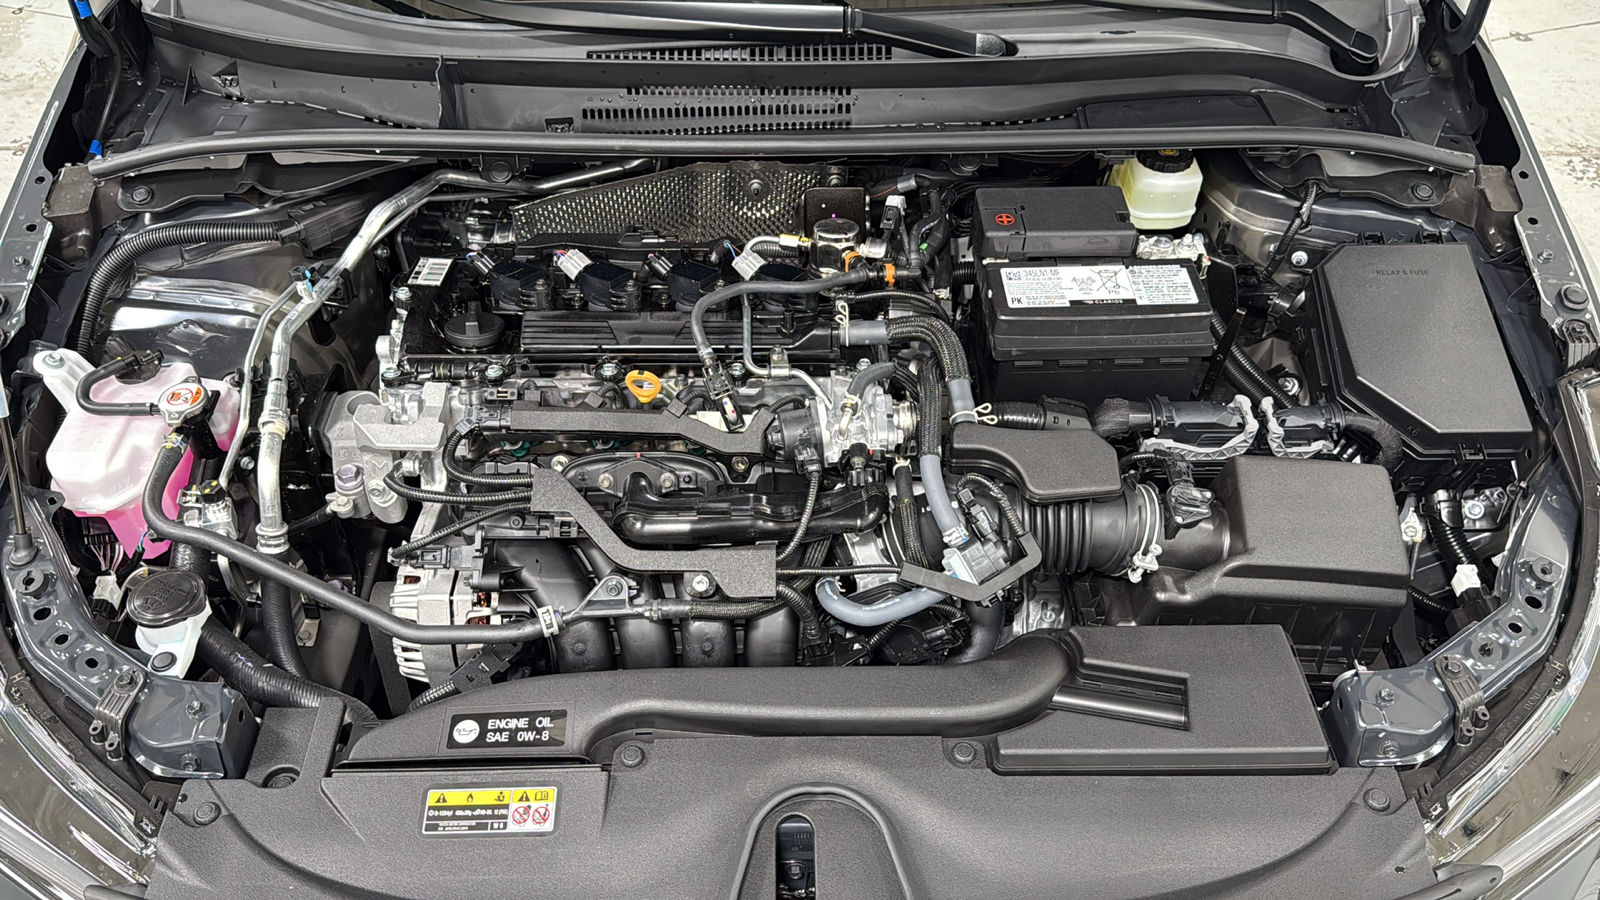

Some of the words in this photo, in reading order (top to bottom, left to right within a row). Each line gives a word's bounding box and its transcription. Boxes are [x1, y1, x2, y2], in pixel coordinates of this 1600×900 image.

[1409, 268, 1430, 276] FUSE
[1010, 296, 1024, 305] PK
[487, 717, 529, 730] ENGINE
[535, 716, 554, 728] OIL
[485, 731, 510, 743] SAE
[517, 730, 550, 742] 0W-8
